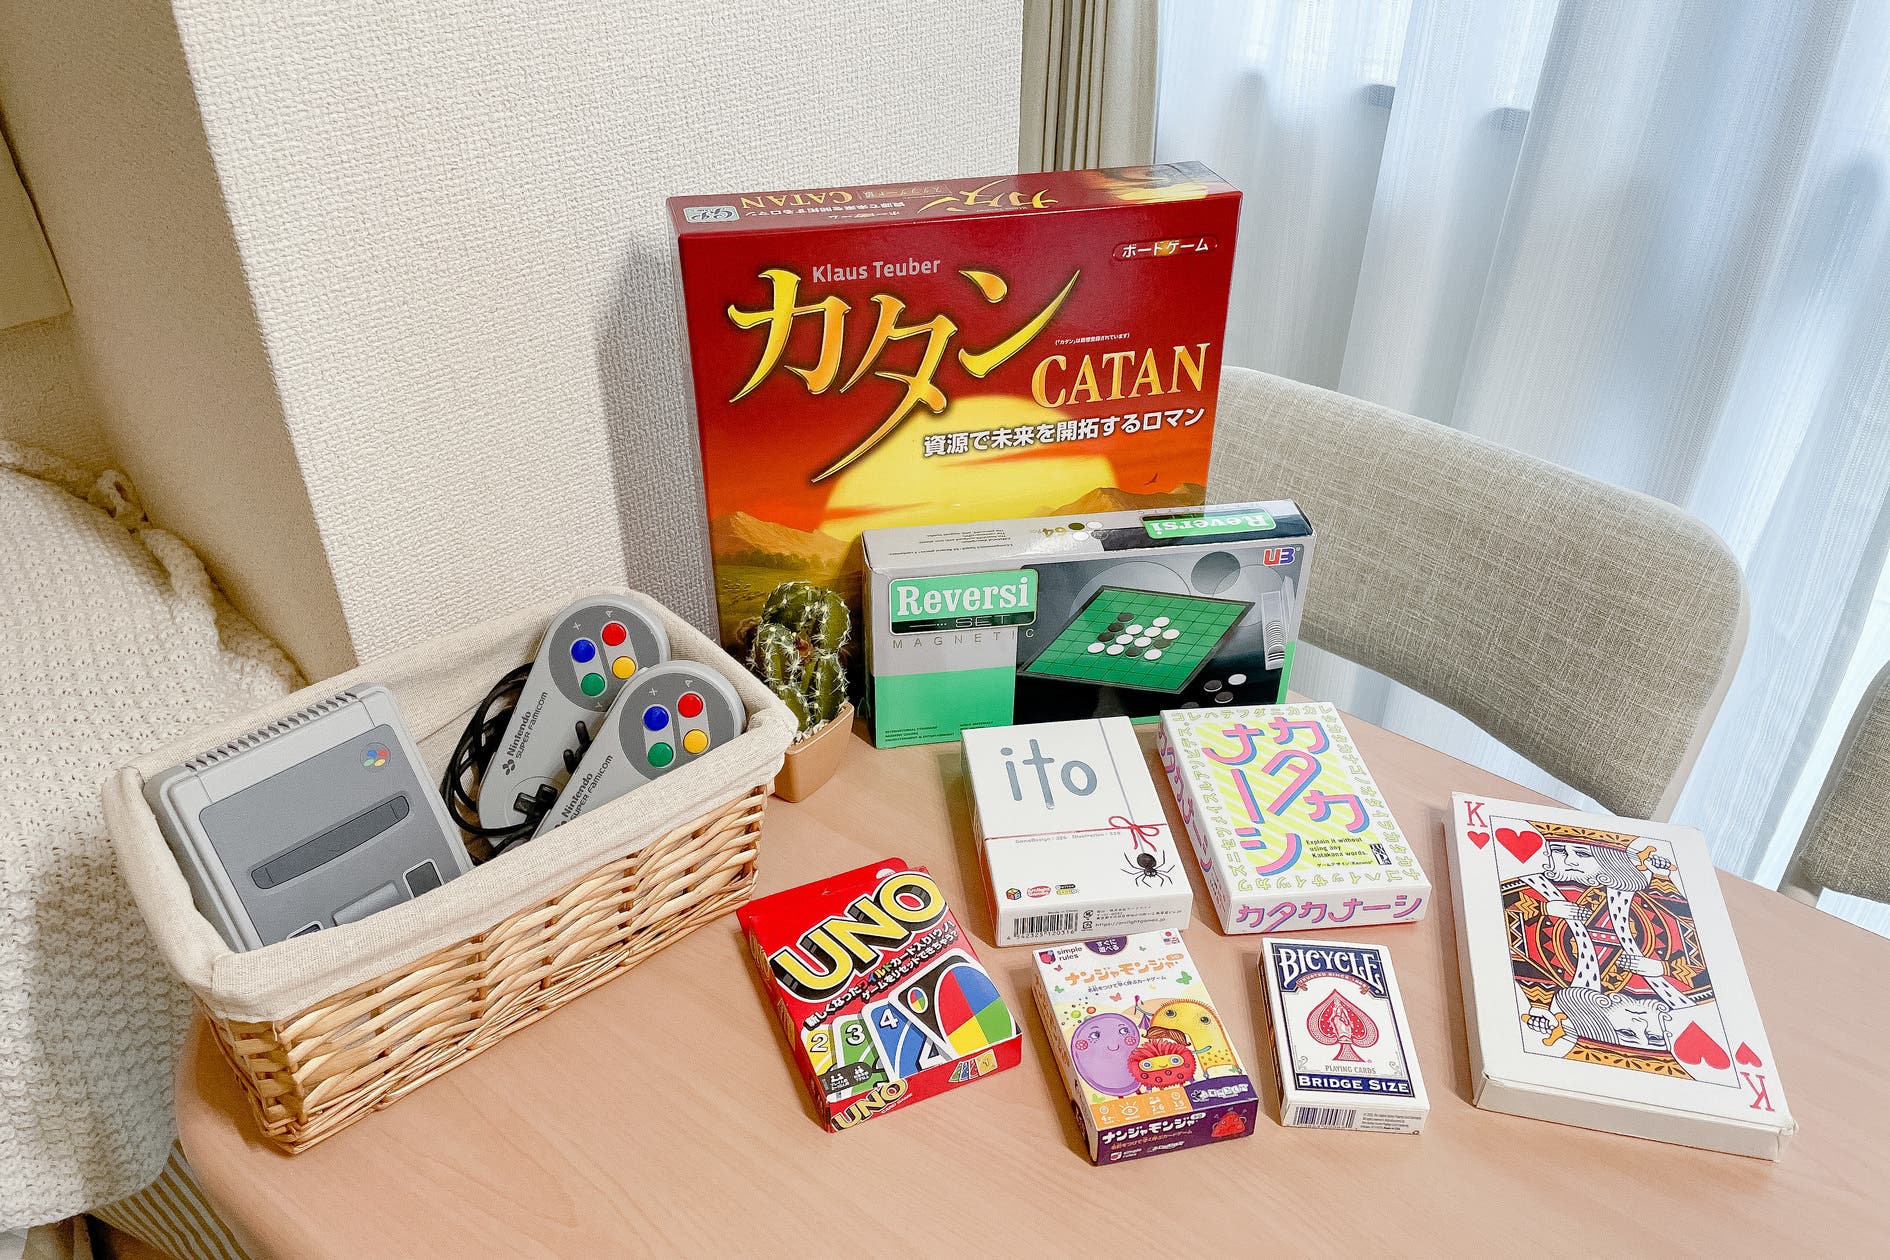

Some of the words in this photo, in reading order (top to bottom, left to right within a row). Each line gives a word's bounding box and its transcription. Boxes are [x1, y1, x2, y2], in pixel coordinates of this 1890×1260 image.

[740, 191, 853, 209] CATAN
[1121, 238, 1209, 259] ボードゲーム
[812, 263, 868, 283] Klaus
[874, 257, 941, 279] Teuber
[727, 268, 1080, 484] カタン
[1031, 342, 1211, 408] CATAN
[923, 407, 1205, 458] 資源で未来を開拓するロマン
[1150, 513, 1270, 536] Reversi
[896, 576, 1030, 617] Reversi
[955, 614, 1010, 628] SET
[892, 628, 1035, 650] MAGNETIC
[507, 710, 532, 757] Nintendo
[515, 732, 532, 760] SUPER
[1000, 738, 1098, 810] ito
[561, 772, 593, 818] Nintendo
[569, 793, 591, 821] SUPER
[1465, 801, 1488, 828] K
[1236, 893, 1423, 933] カタカナーシ
[769, 870, 948, 998] UNO
[1057, 947, 1082, 956] simple
[1059, 954, 1079, 962] rules
[1278, 948, 1384, 994] BICYCLE
[879, 1009, 899, 1029] 4
[811, 1033, 829, 1052] 2
[847, 1024, 866, 1045] 3
[1325, 1065, 1352, 1073] PLAYING
[1299, 1075, 1363, 1090] BRIDGE
[1369, 1079, 1410, 1093] SIZE
[1740, 1073, 1775, 1111] K
[832, 1079, 907, 1131] UNO
[1102, 1116, 1198, 1145] ナンジャモンジャ
